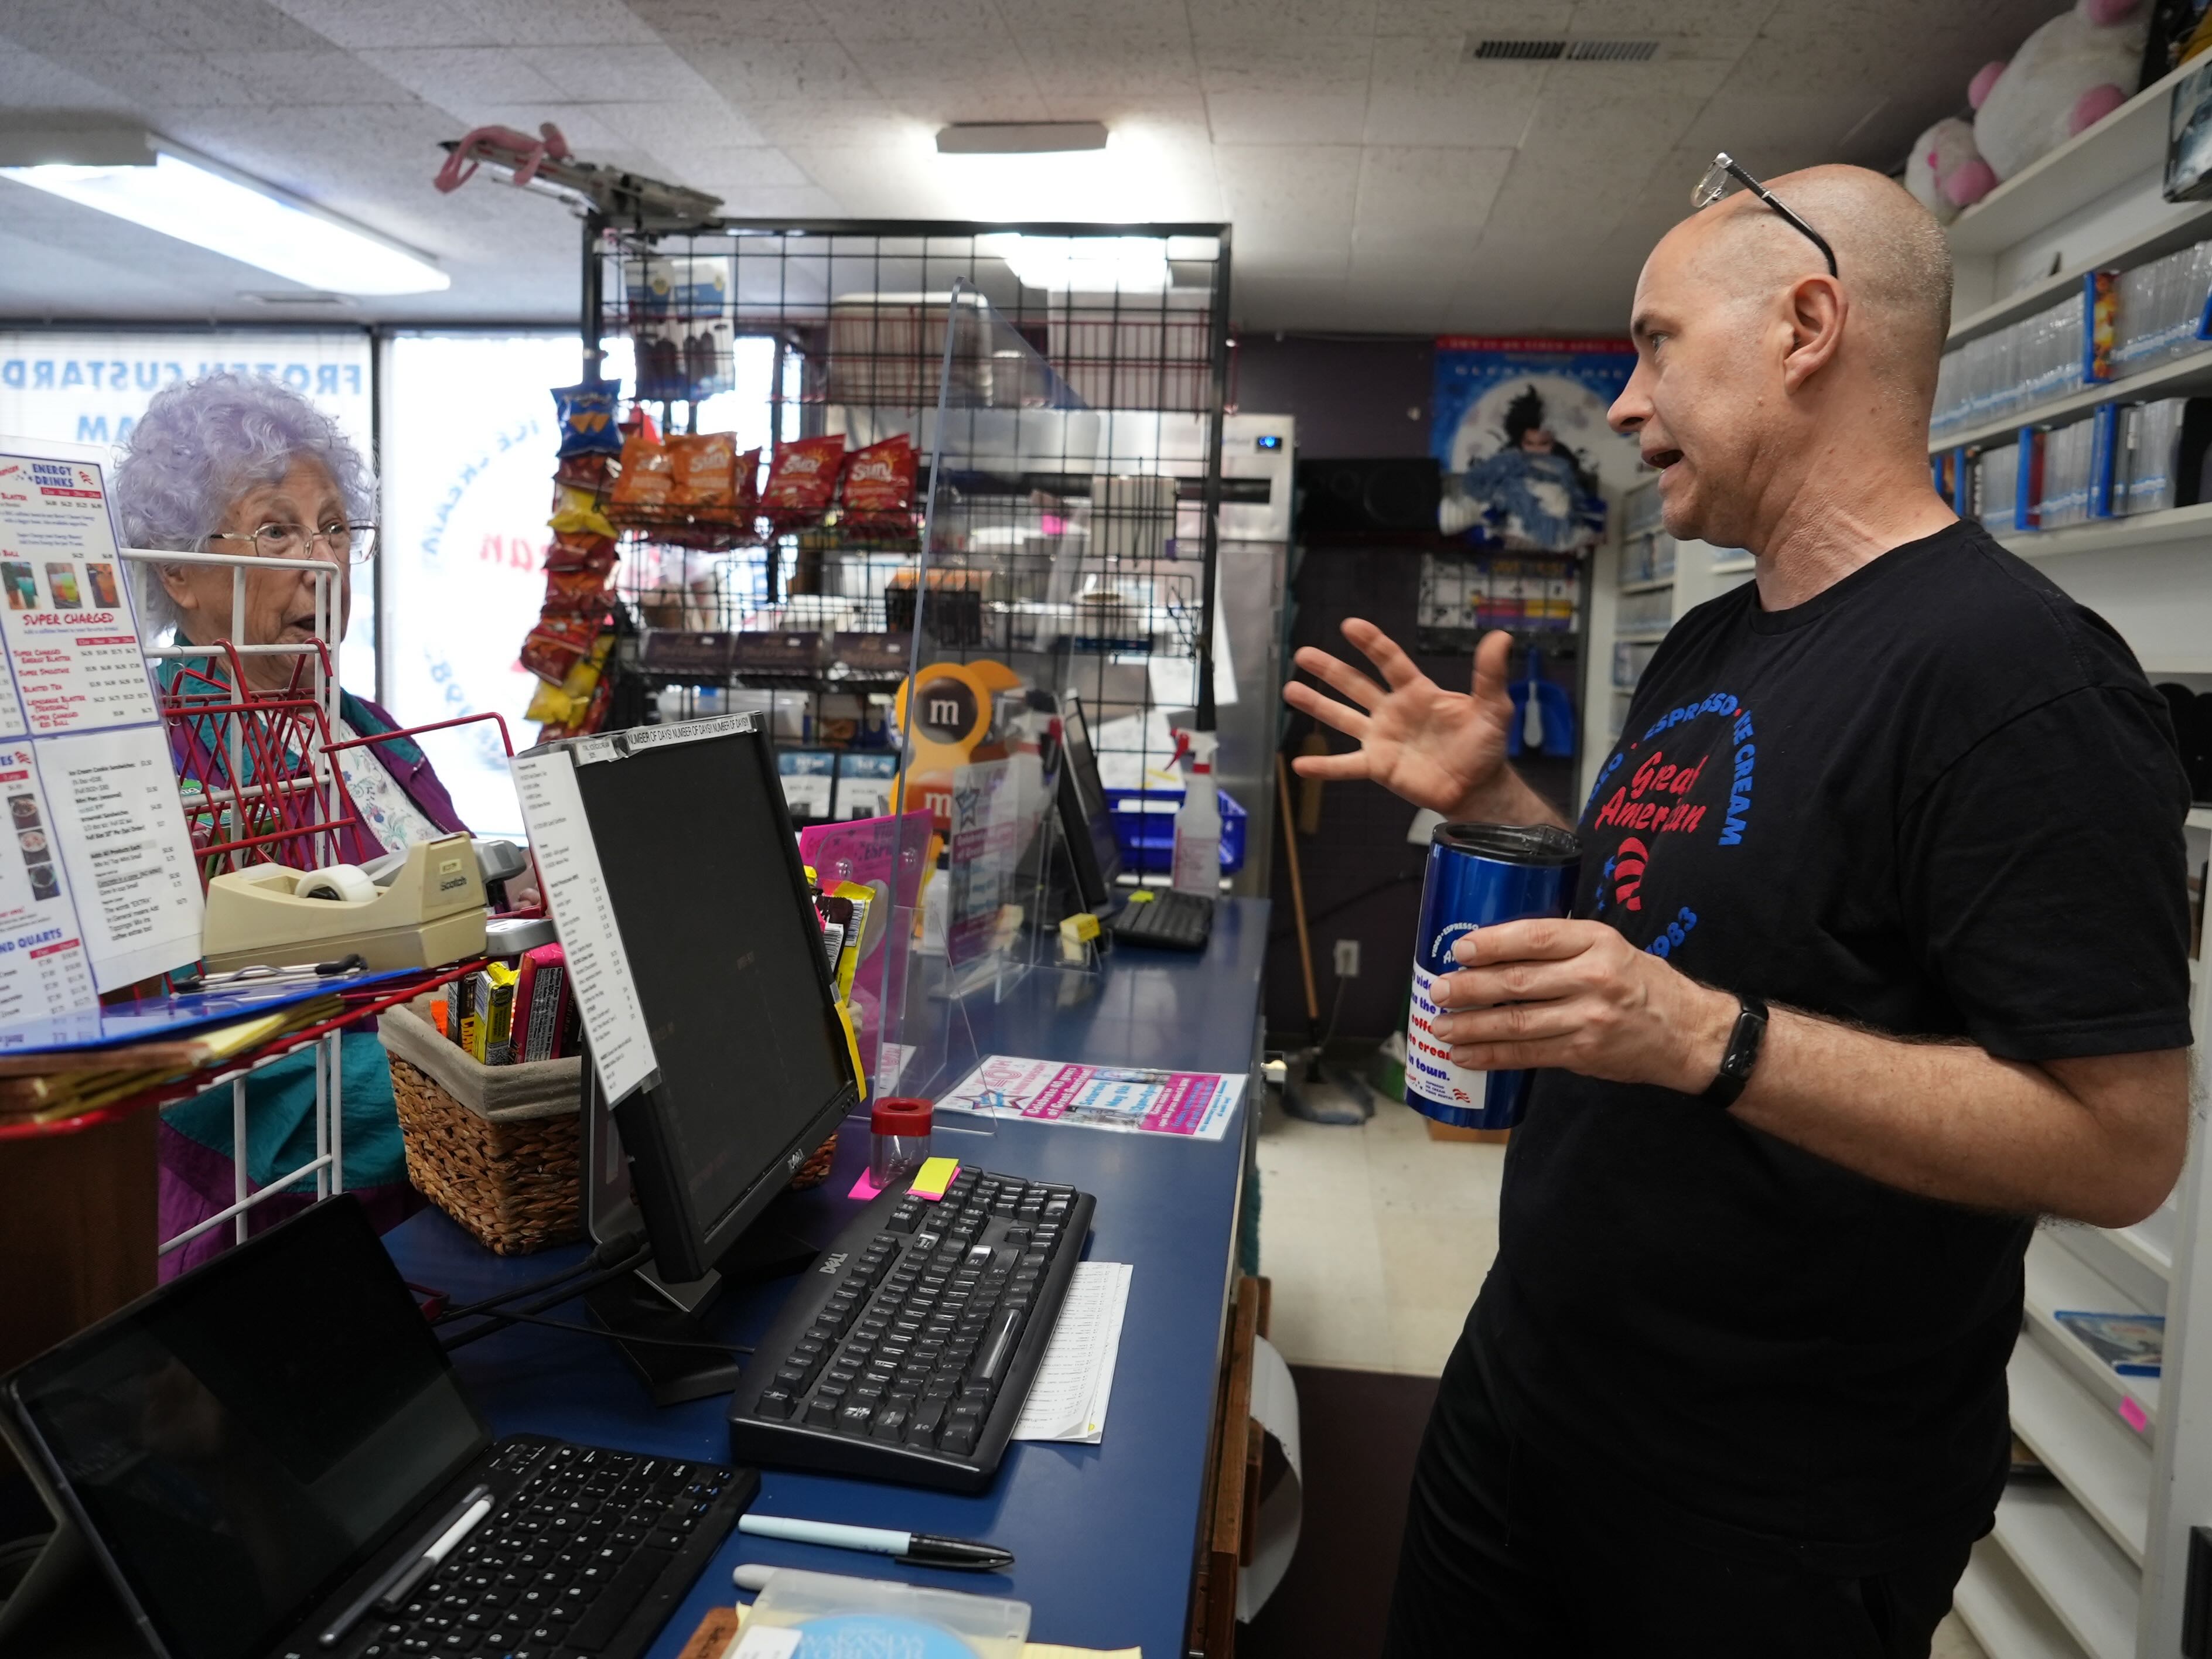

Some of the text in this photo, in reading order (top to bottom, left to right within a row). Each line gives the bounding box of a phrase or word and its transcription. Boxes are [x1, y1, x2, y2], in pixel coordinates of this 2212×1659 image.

[32, 463, 73, 476] ENERGY
[35, 475, 75, 487] DRINKS
[22, 612, 115, 626] SUPER CHARGED
[930, 699, 960, 726] m
[627, 733, 652, 745] NUMBER
[650, 730, 658, 742] OF
[673, 726, 692, 738] NUMBER
[691, 725, 699, 736] OF
[712, 720, 730, 732] NUMBER
[730, 718, 736, 729] OF
[1643, 692, 1756, 846] ESPRESSO ICE CREAM
[924, 792, 953, 817] m
[1594, 786, 1707, 834] Amerian
[439, 875, 468, 892] Scotch
[0, 928, 63, 952] ND QUARTS
[1431, 922, 1480, 958] VIDEO ESPRESSO
[1419, 996, 1436, 1015] the
[1415, 1057, 1450, 1081] town.
[1026, 1067, 1077, 1114] Celebrate 40 years
[1047, 1067, 1093, 1116] of Great American!
[787, 1148, 805, 1172] DELL
[818, 1252, 849, 1275] DELL
